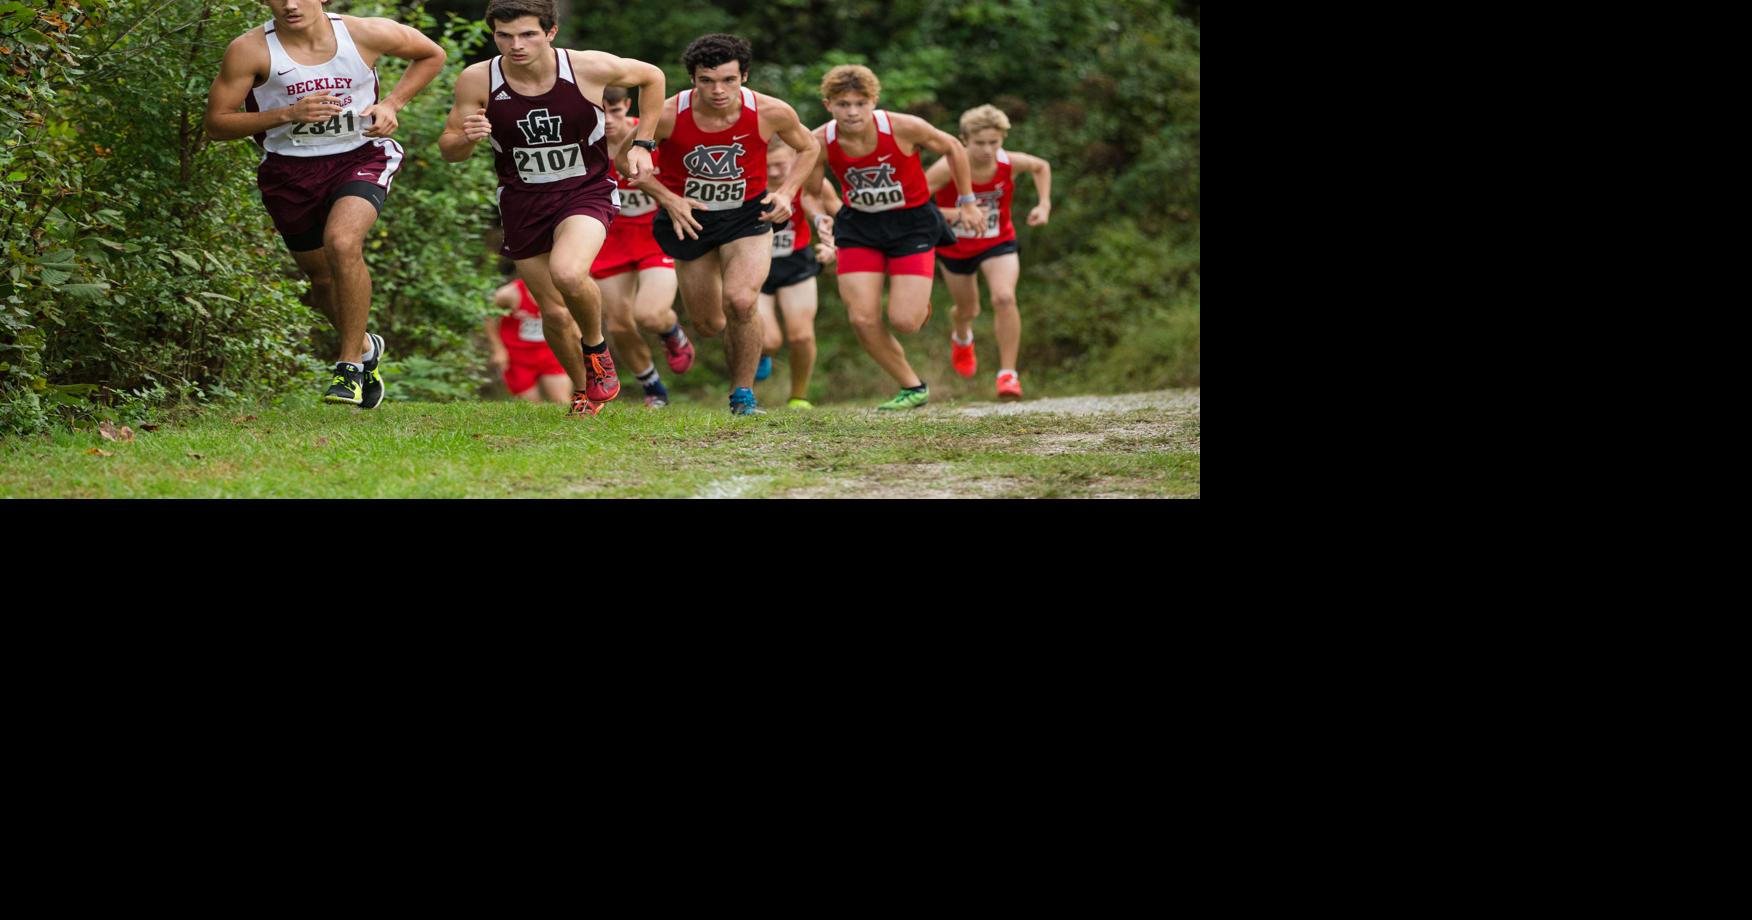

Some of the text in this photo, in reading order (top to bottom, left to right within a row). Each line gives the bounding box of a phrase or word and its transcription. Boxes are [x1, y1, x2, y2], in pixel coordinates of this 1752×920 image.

[286, 78, 352, 95] BECKLEY
[292, 111, 354, 134] 2341
[515, 146, 579, 172] 2107
[619, 191, 650, 208] 241
[685, 181, 744, 202] 2035
[848, 190, 902, 206] 2040
[772, 234, 791, 249] 45
